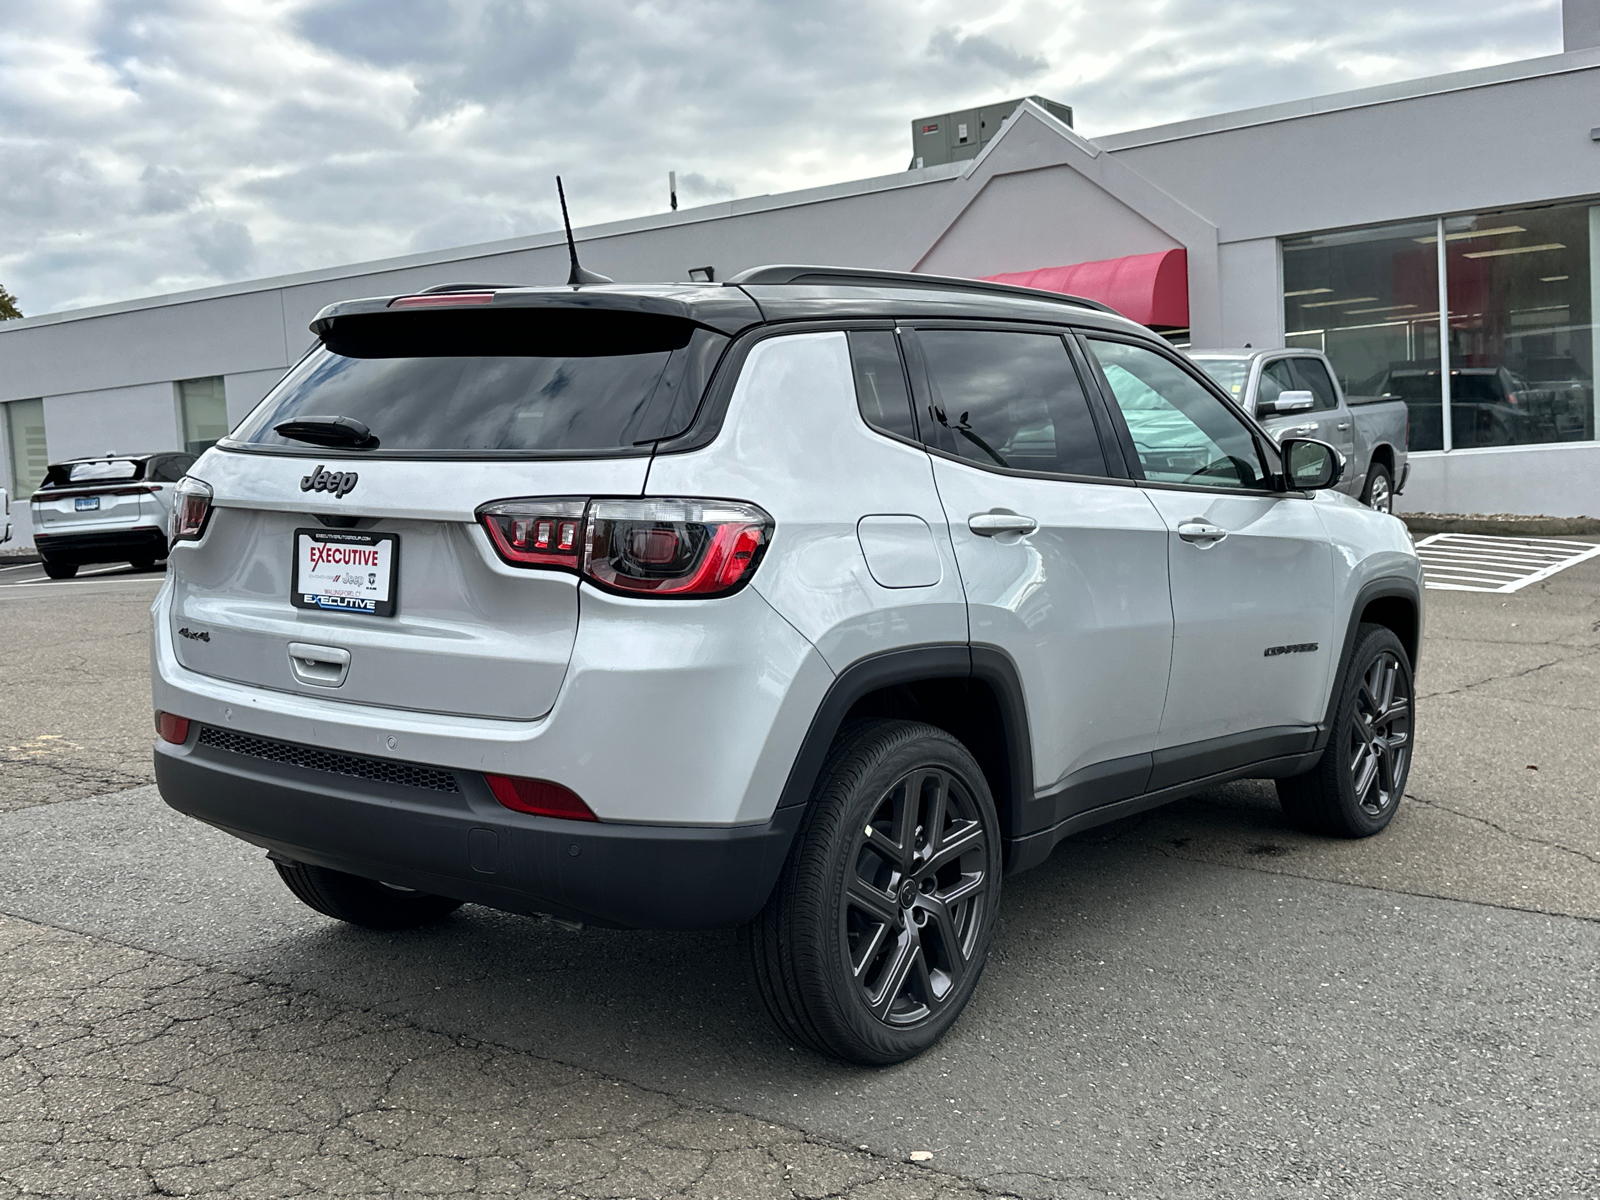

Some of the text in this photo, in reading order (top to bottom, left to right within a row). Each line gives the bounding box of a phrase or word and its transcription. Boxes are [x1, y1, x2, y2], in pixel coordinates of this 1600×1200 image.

[300, 464, 359, 499] Jeep
[310, 543, 379, 569] EXECUTIVE
[342, 572, 364, 588] Jeep
[304, 594, 376, 610] EXECUTIVE
[829, 833, 853, 986] ContiProContact
